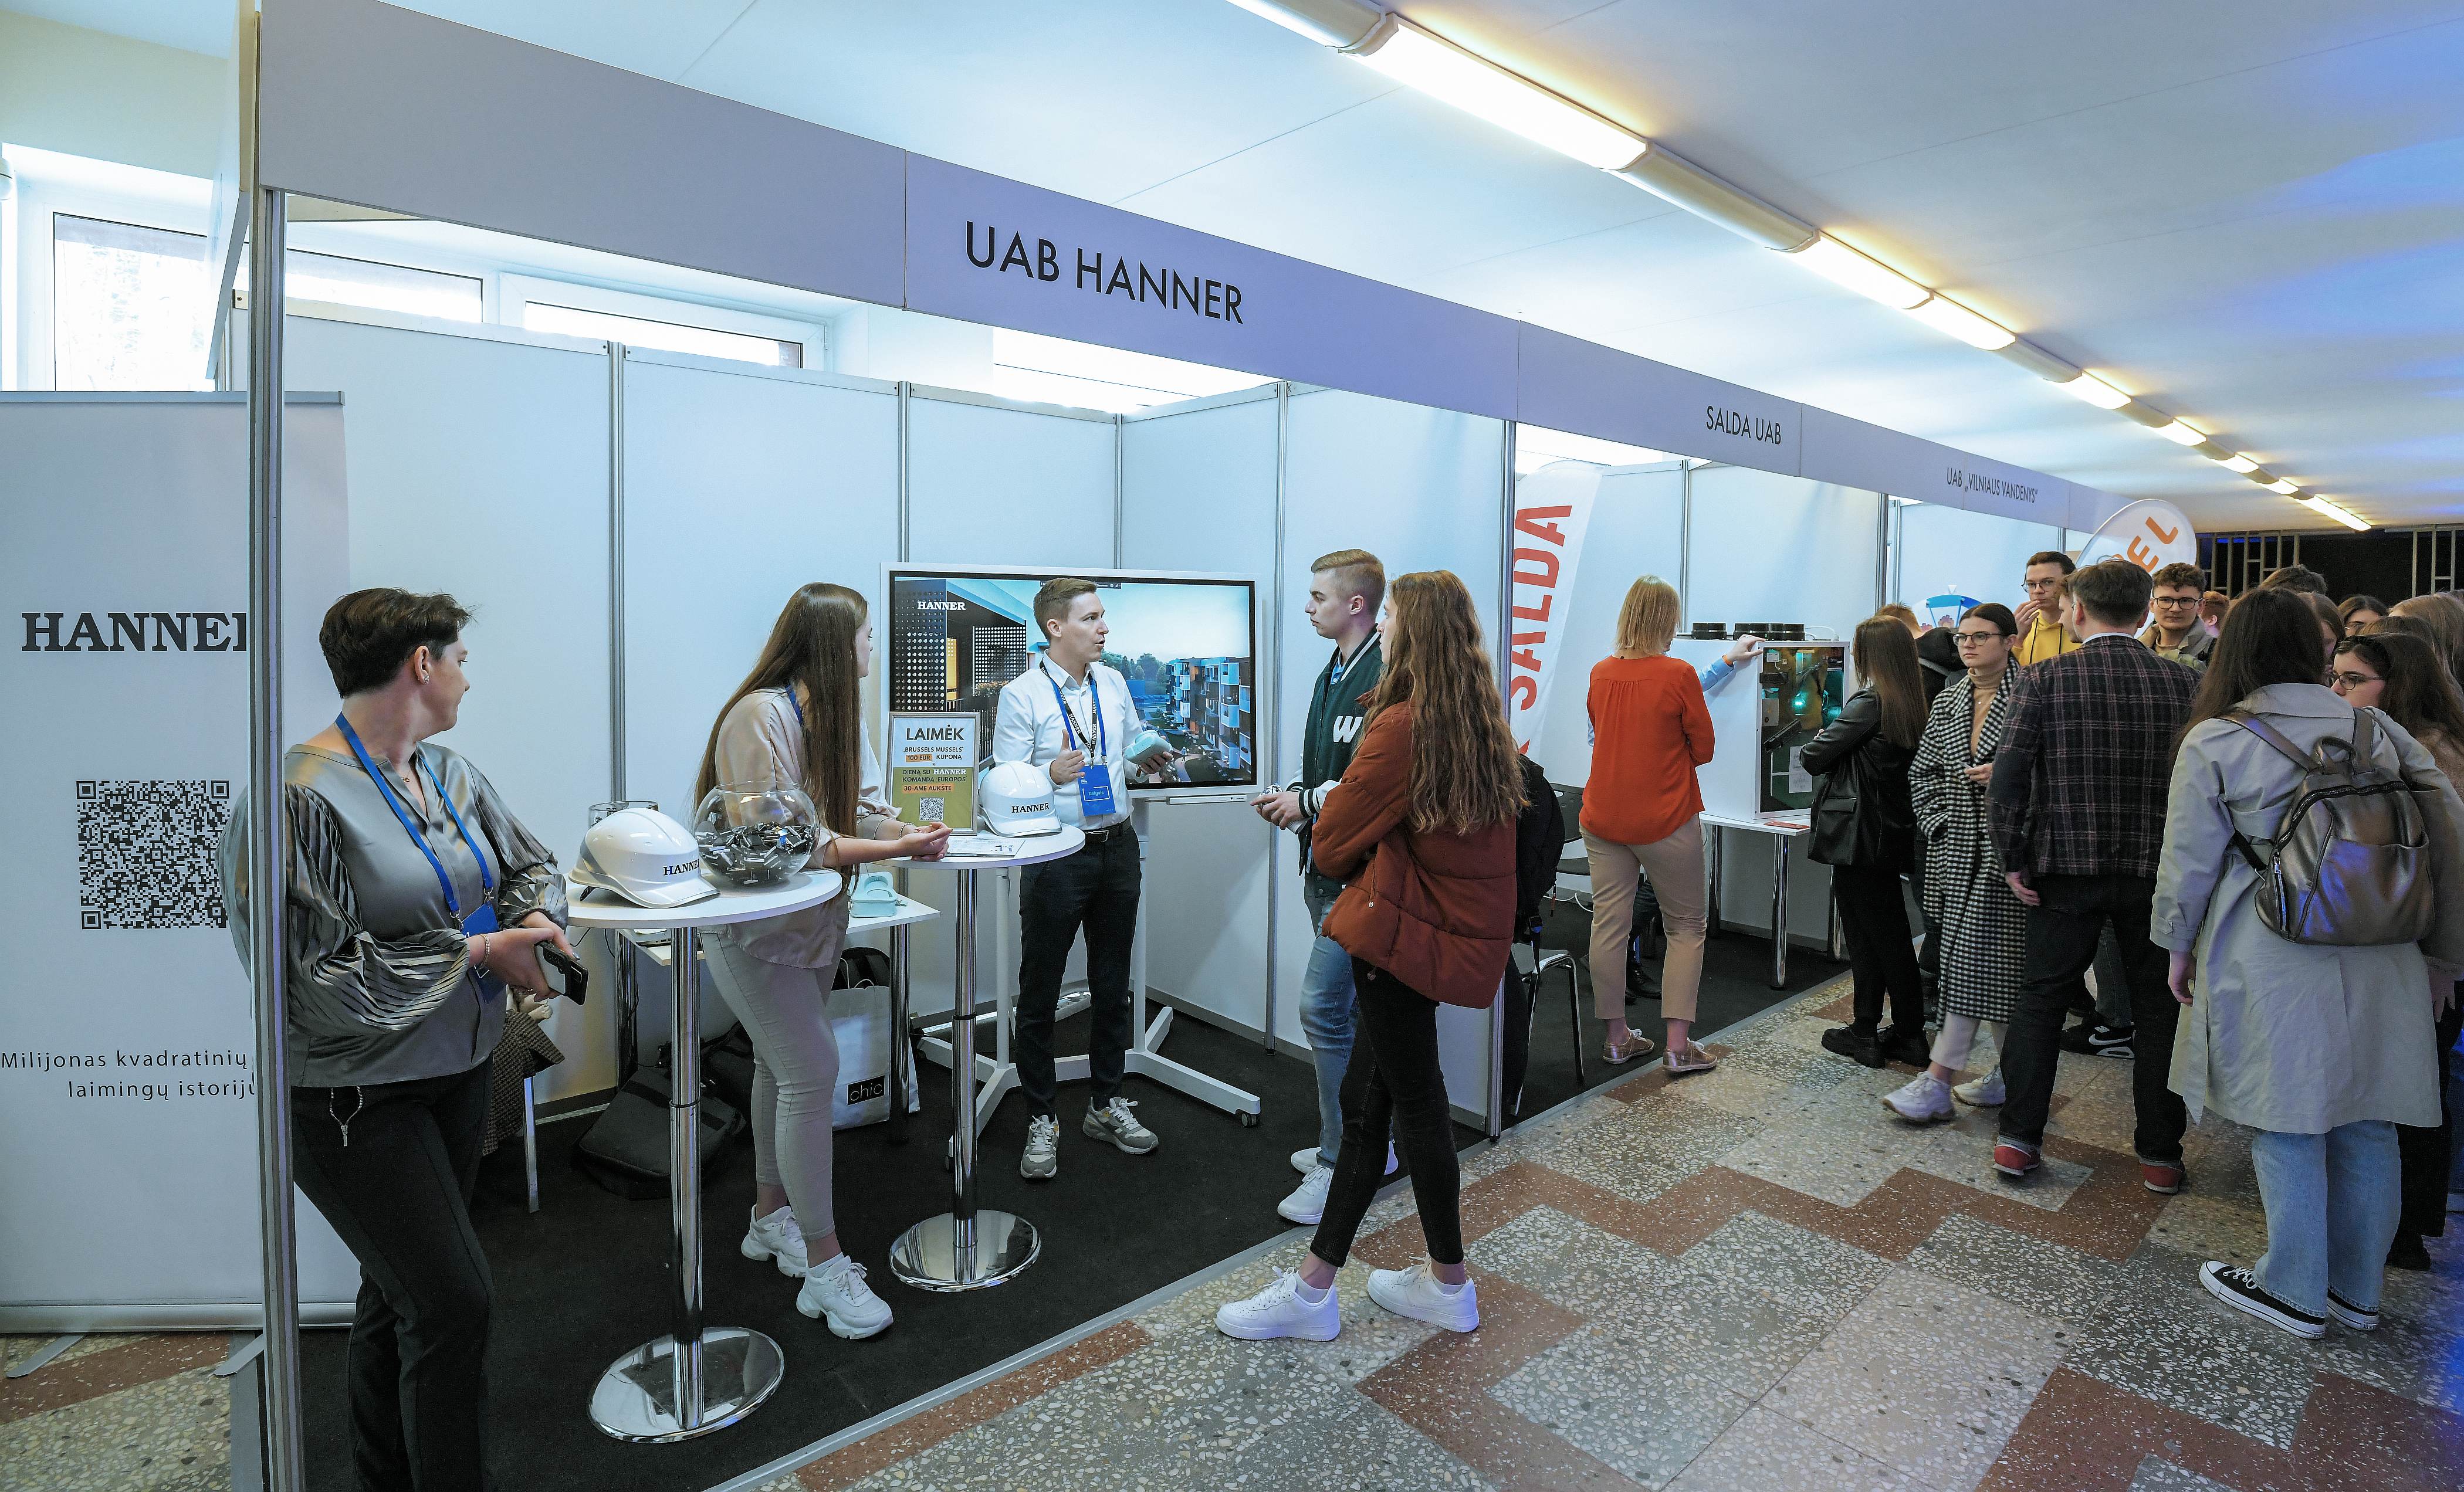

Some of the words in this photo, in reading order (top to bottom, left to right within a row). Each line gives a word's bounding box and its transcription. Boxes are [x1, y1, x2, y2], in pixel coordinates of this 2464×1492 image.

[966, 220, 1060, 283] UAB
[1076, 247, 1244, 325] HANNER
[1706, 405, 1751, 439] SALDA
[1755, 417, 1782, 445] UAB
[1947, 467, 1962, 487] UAB
[2112, 516, 2179, 573] EL
[917, 601, 966, 611] HANNER
[1511, 504, 1573, 711] SALDA
[906, 724, 964, 741] LAIMĖK
[1068, 713, 1082, 734] HANNER
[1333, 716, 1363, 743] W
[1011, 802, 1050, 813] HANNER
[1, 1052, 107, 1071] Milijonas
[116, 1050, 248, 1070] kvadratinių
[69, 1081, 169, 1101] laimingų
[850, 1083, 883, 1101] chic
